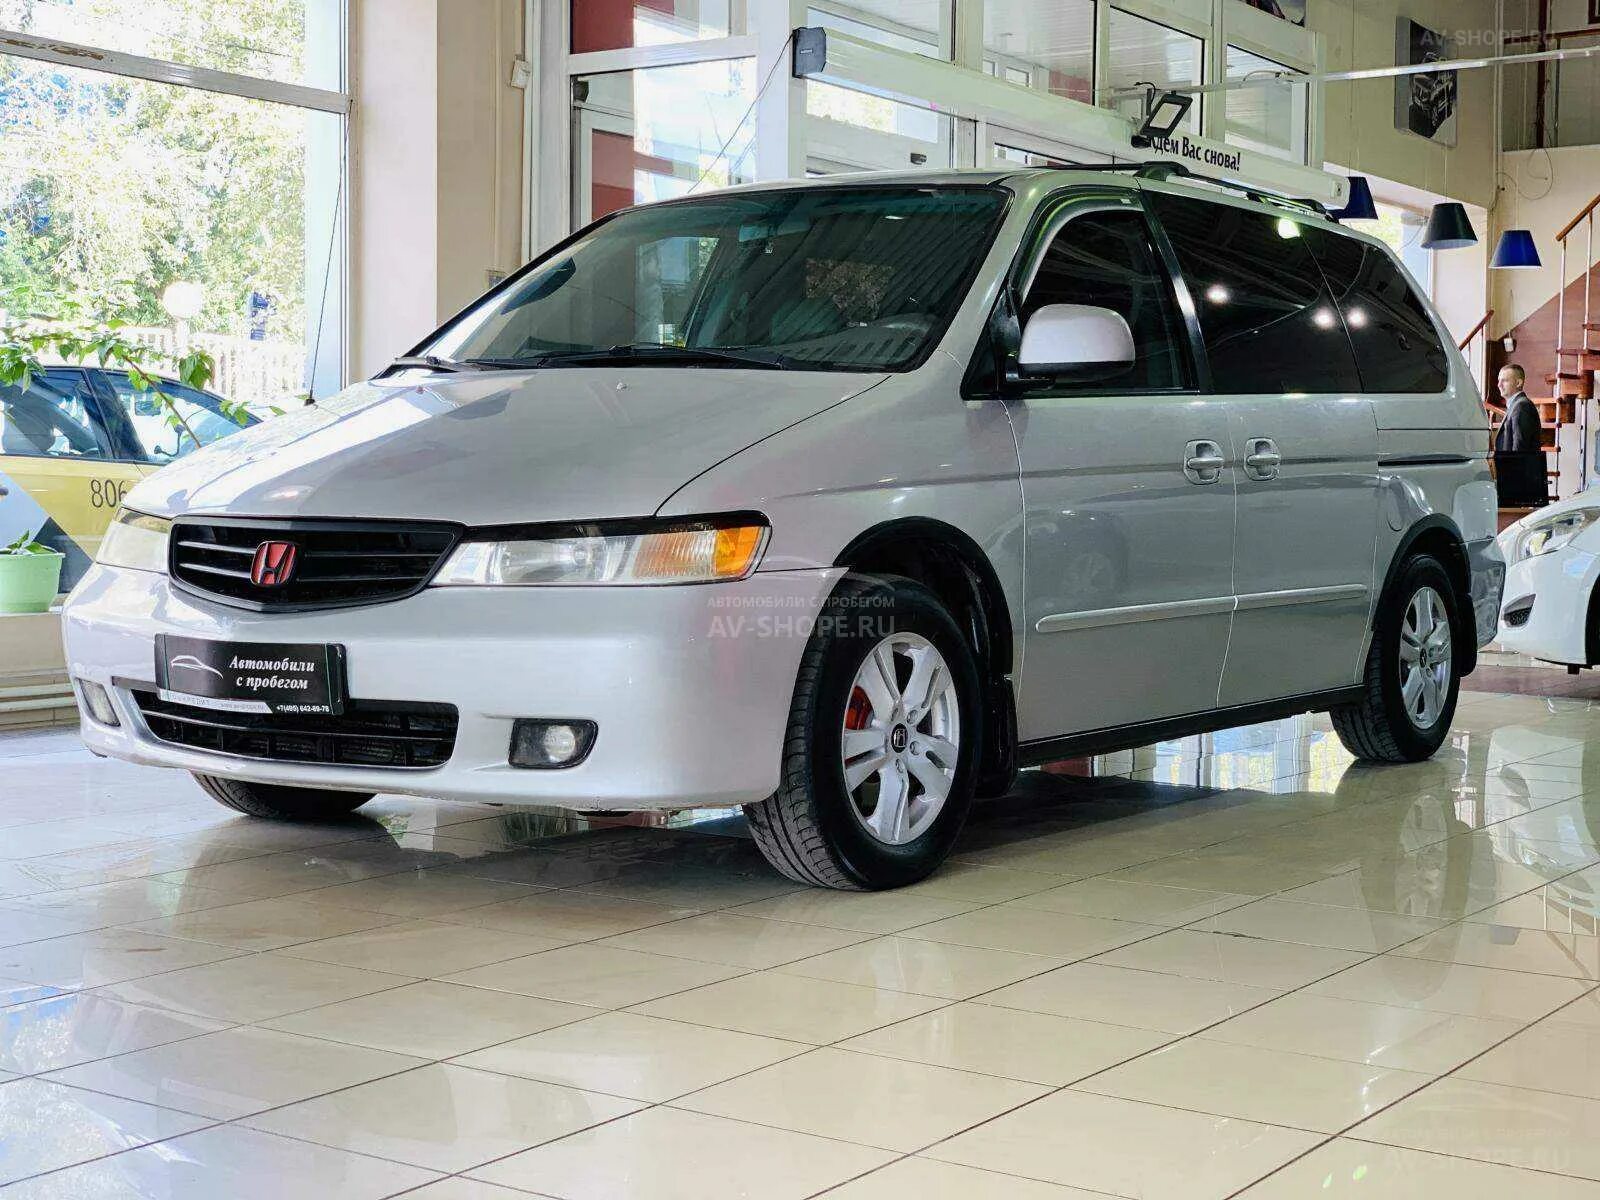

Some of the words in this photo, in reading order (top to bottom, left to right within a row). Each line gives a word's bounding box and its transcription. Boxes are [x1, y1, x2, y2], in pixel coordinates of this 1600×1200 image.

[1182, 136, 1202, 160] Вас
[1204, 149, 1241, 171] снова!
[229, 655, 315, 673] Автомобили
[236, 677, 244, 687] с
[245, 676, 308, 691] пробегом
